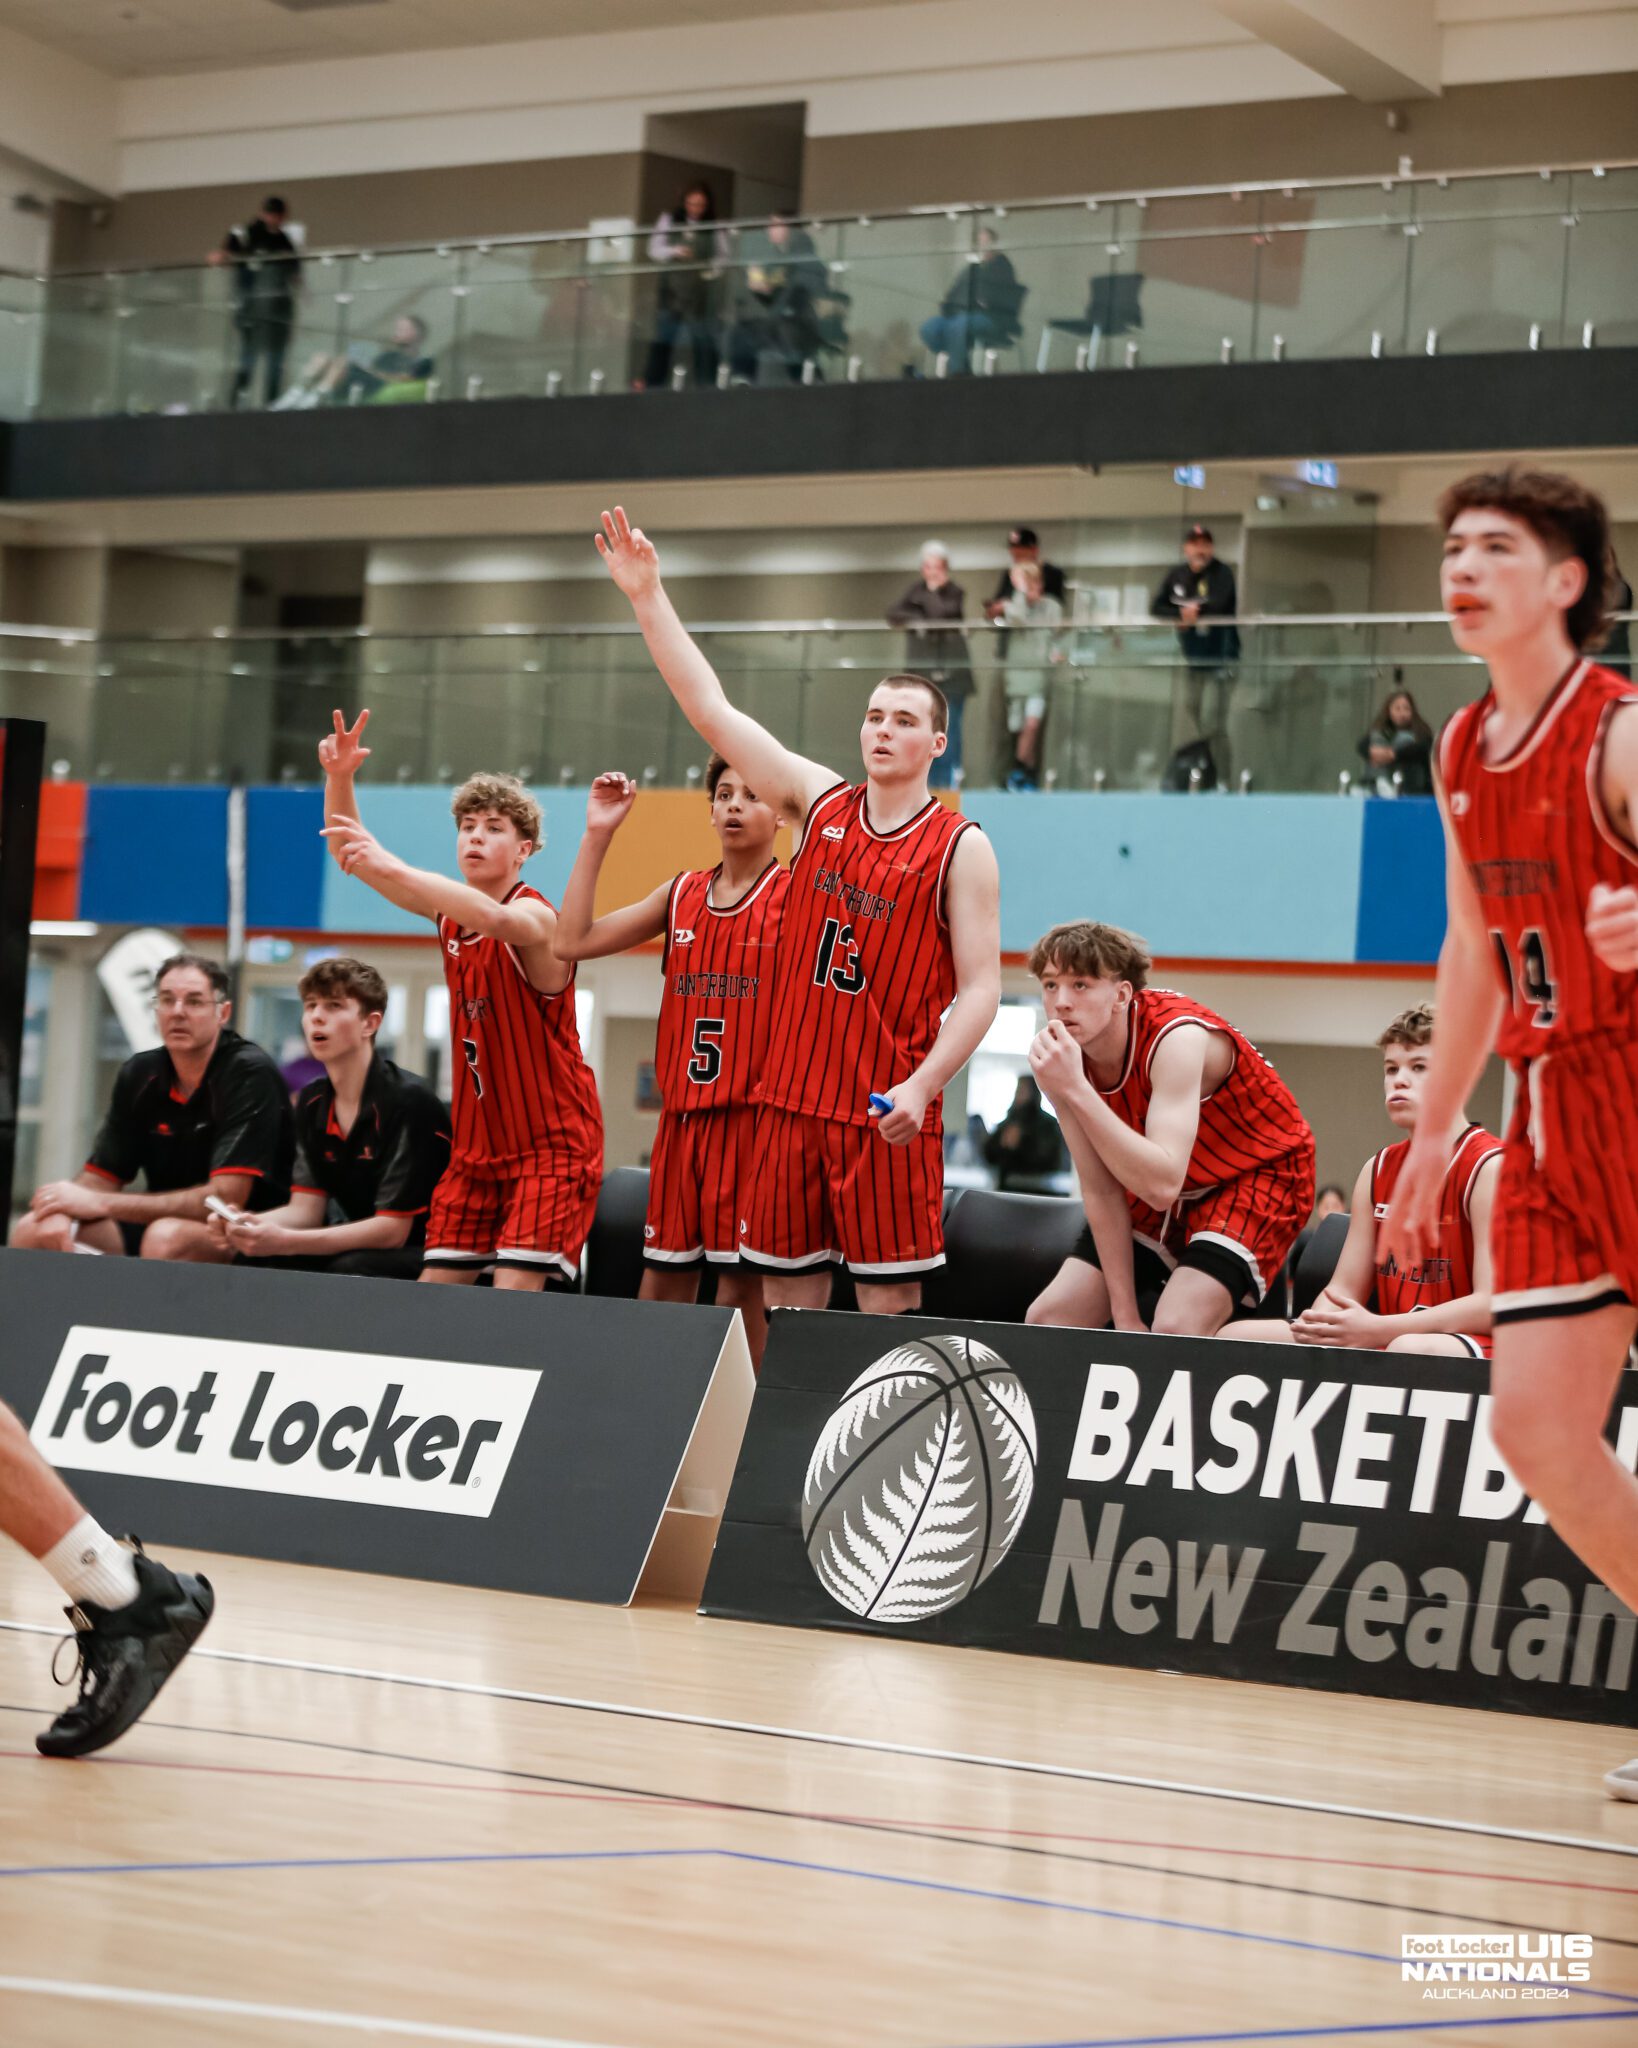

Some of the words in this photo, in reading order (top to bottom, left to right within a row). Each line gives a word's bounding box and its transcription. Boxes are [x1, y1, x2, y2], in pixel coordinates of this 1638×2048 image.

[813, 867, 897, 923] CANTRBURY
[813, 917, 867, 996] 13
[686, 1018, 725, 1085] 5
[50, 1353, 217, 1454] Foot
[230, 1371, 503, 1486] Locker
[1066, 1363, 1638, 1526] BASKETB
[1037, 1498, 1266, 1645] New
[1276, 1521, 1638, 1691] Zealan
